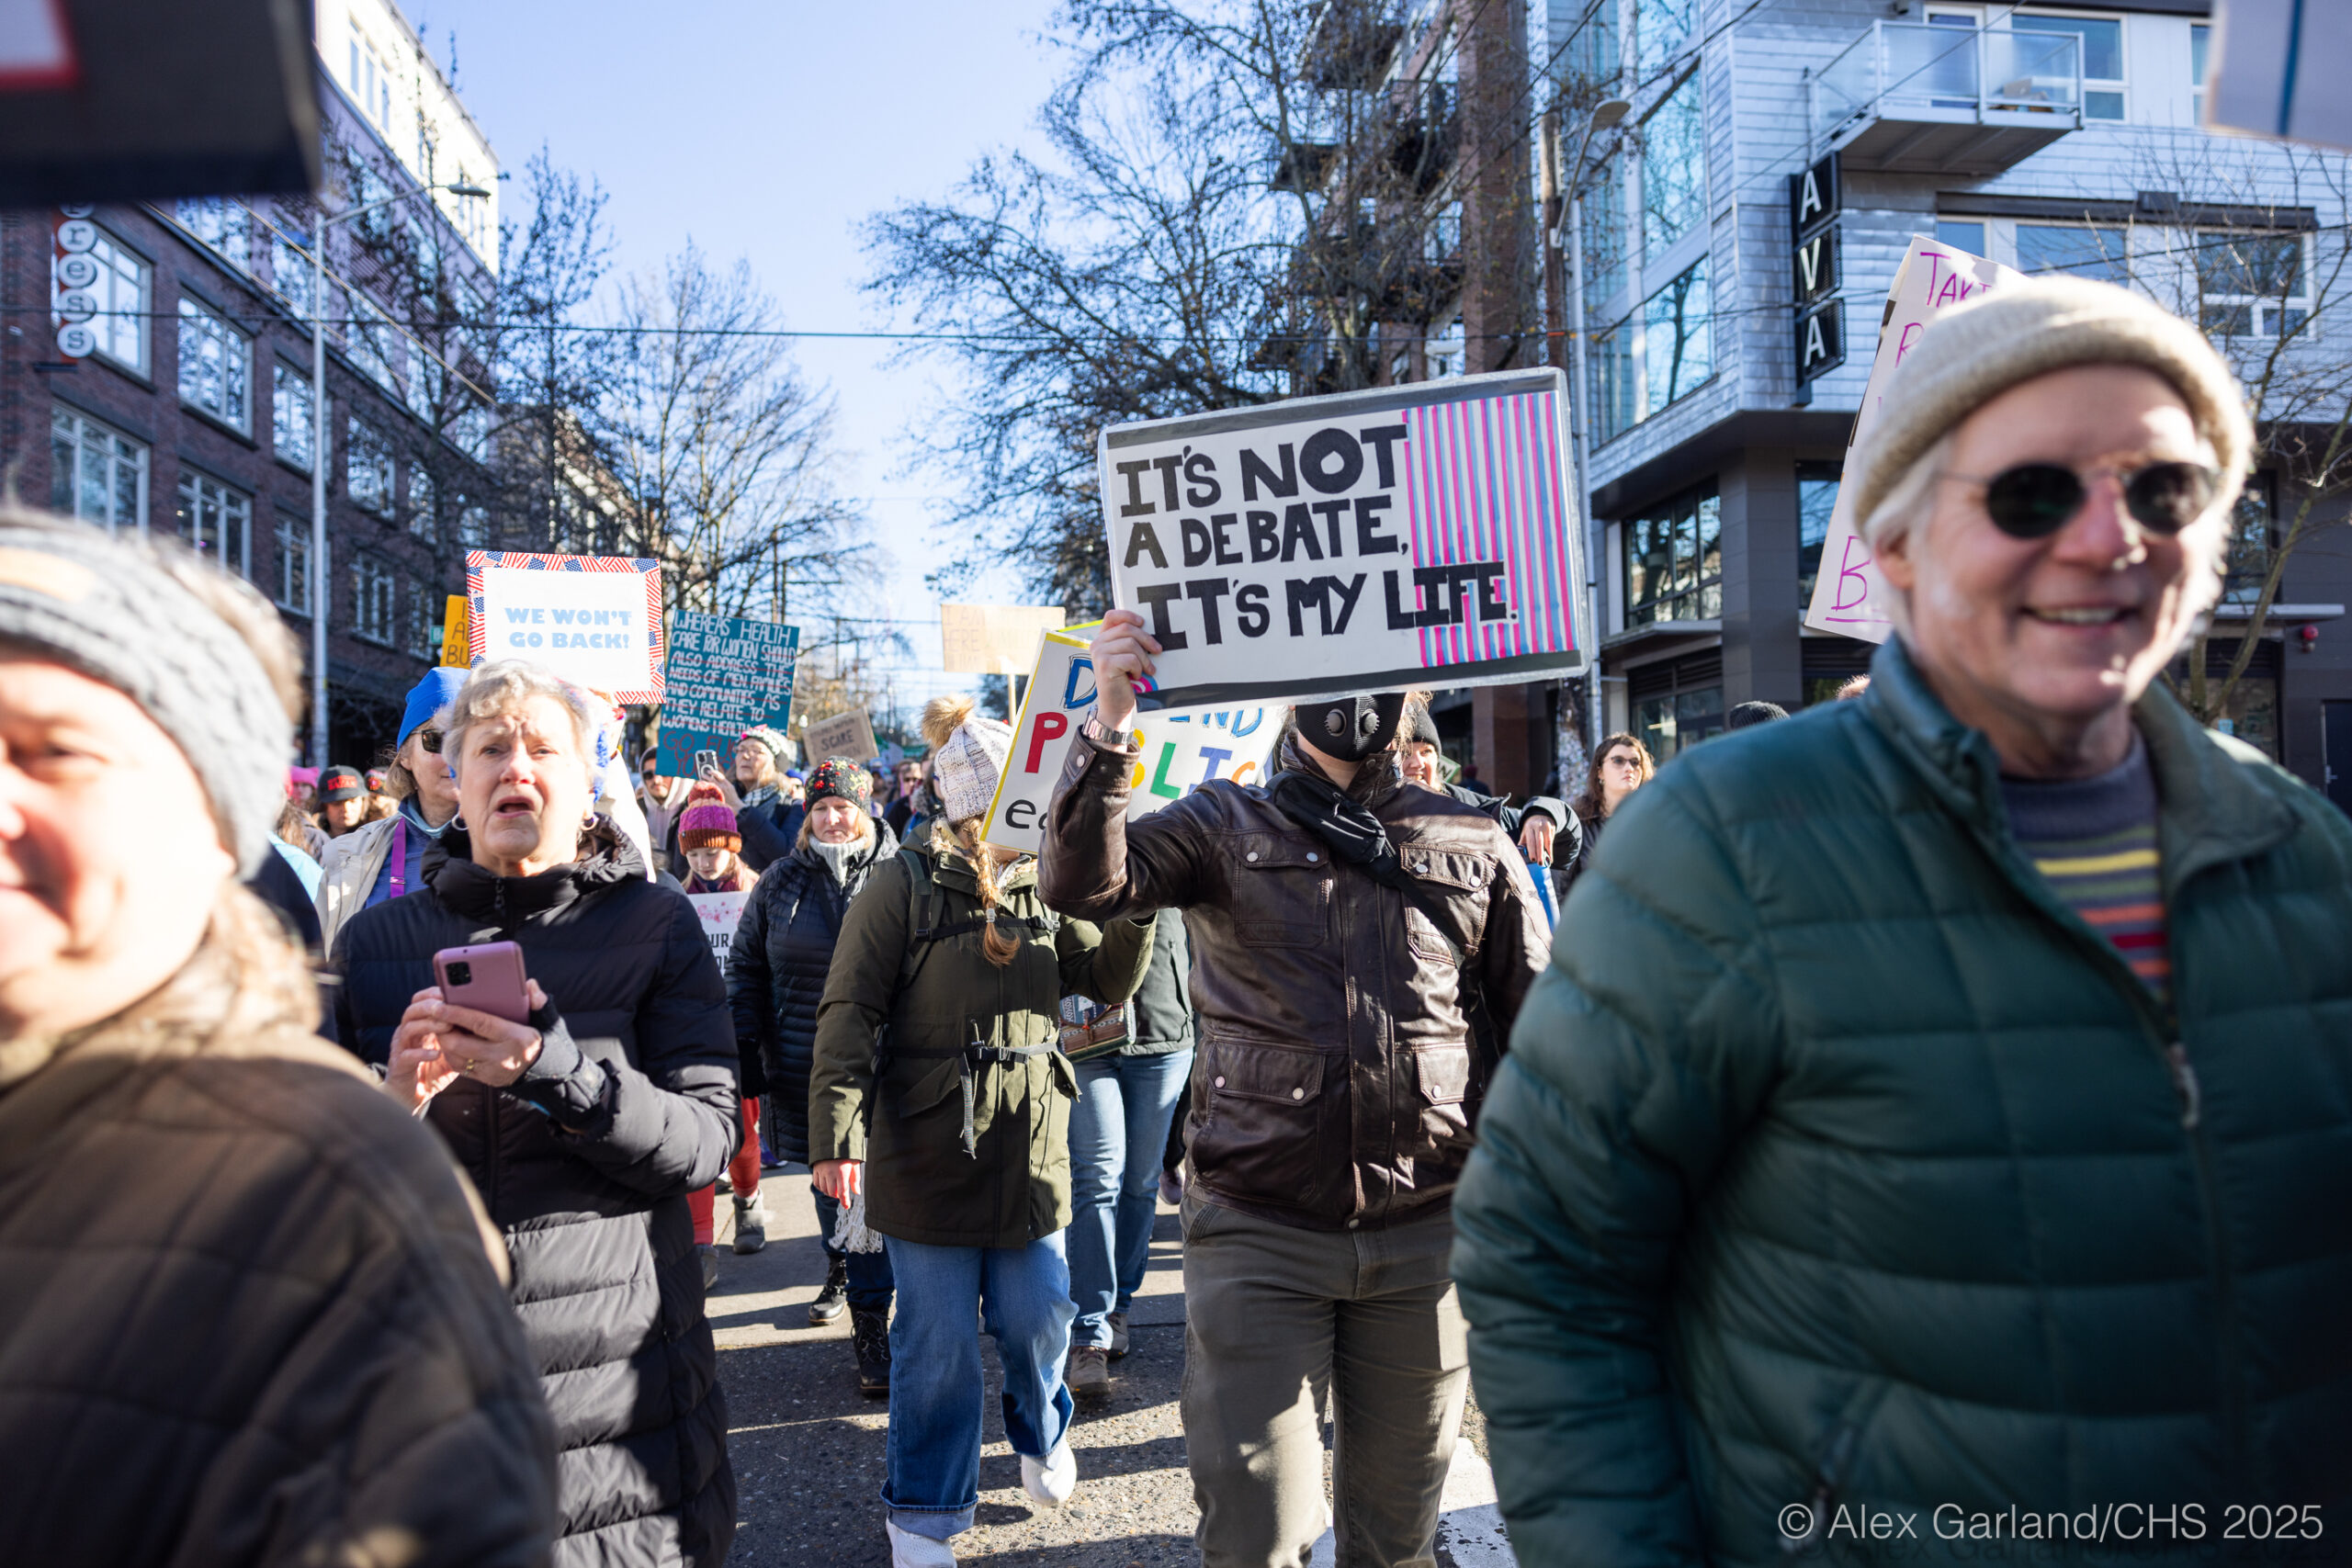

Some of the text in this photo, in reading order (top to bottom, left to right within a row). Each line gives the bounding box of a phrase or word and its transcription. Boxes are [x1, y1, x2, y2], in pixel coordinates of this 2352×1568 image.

[1800, 170, 1826, 367] AVA
[1116, 423, 1408, 517] IT'S NOT
[1124, 494, 1408, 569] A DEBATE,
[504, 608, 632, 626] WE WON'T
[1137, 577, 1271, 653] IT'S
[1285, 572, 1368, 637] MY
[1383, 560, 1518, 631] LIFE.
[509, 632, 629, 649] GO BACK!
[673, 611, 791, 647] WHEREAS HEALTH
[672, 631, 796, 666] CARE FOR WOMEN SHOULD
[669, 666, 702, 682] NEEDS
[703, 670, 721, 684] OF
[671, 650, 790, 679] ALSO ADDRESS THE
[665, 697, 764, 722] THEY RELATE TO
[666, 681, 688, 696] AND
[762, 693, 780, 711] AS
[663, 730, 695, 751] GO
